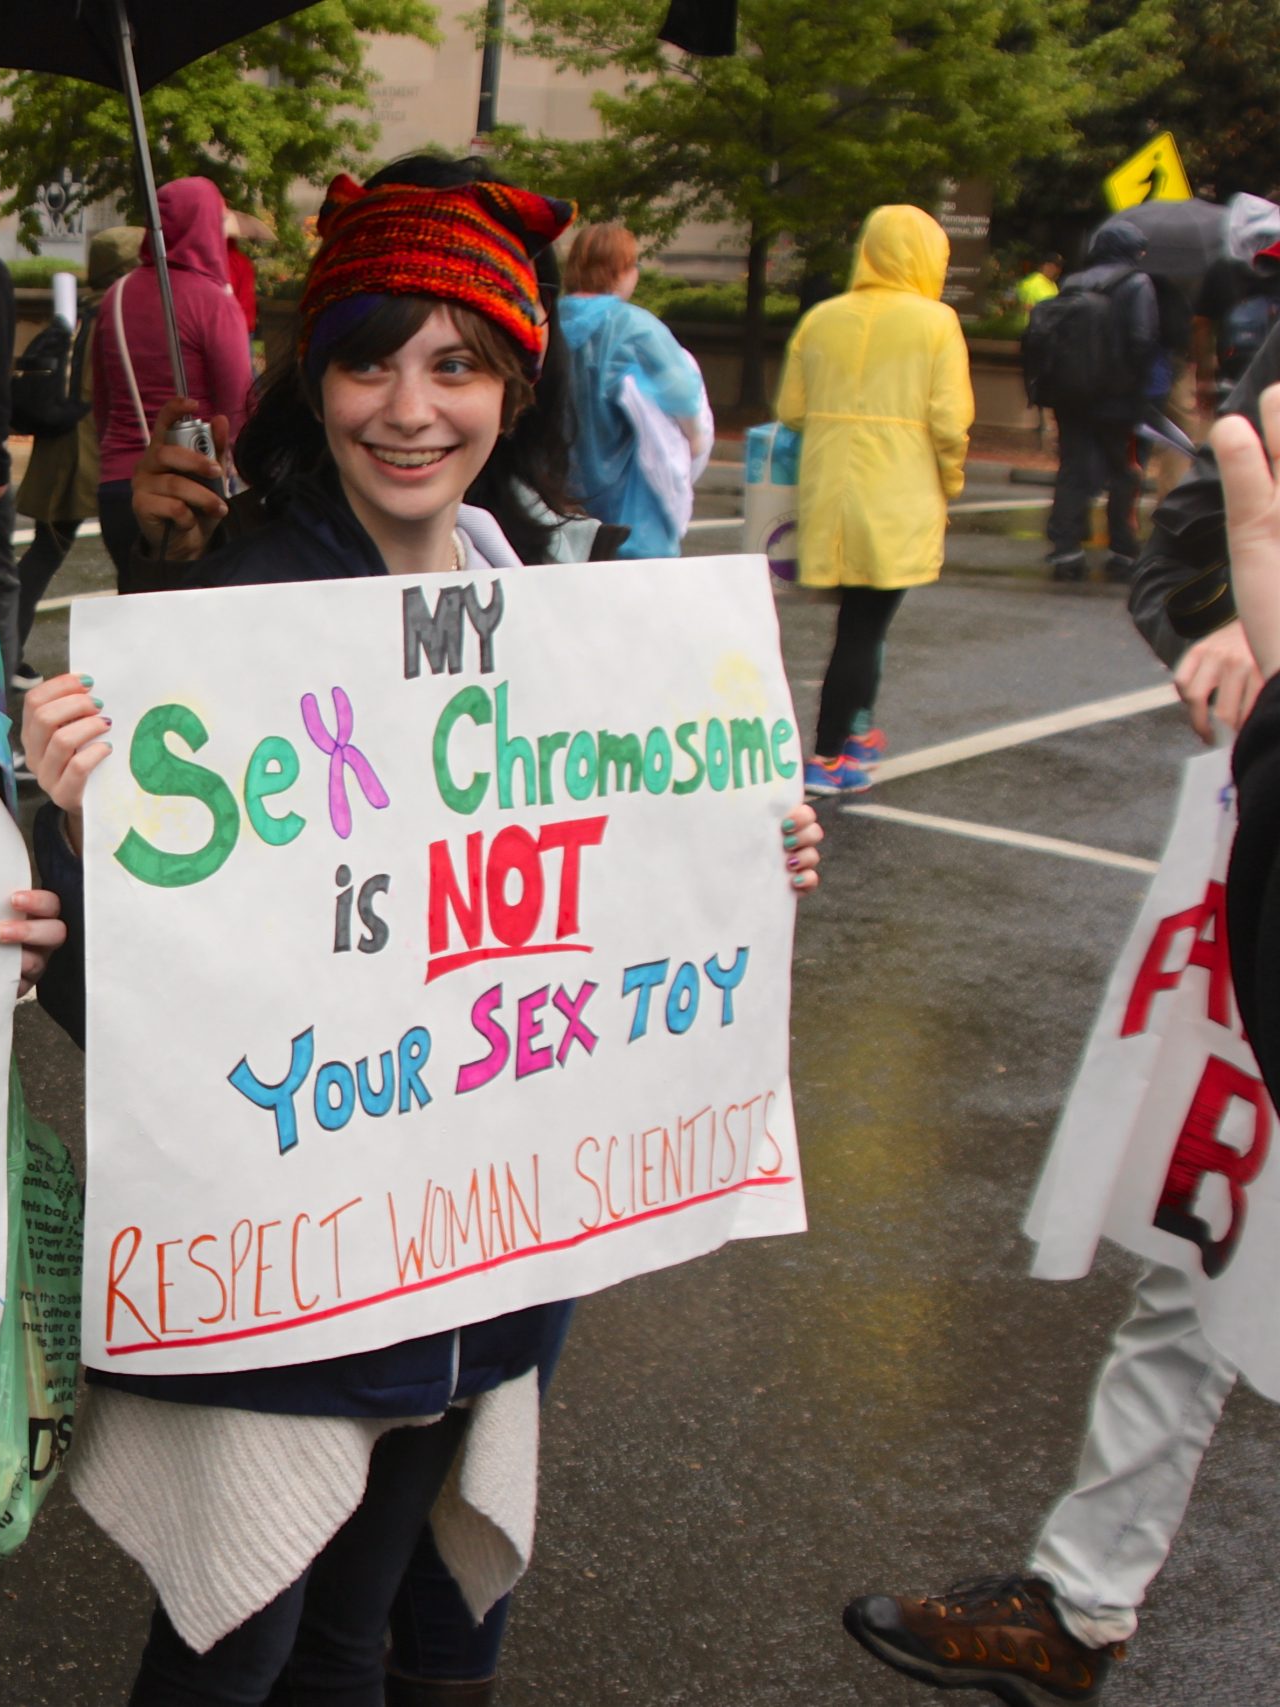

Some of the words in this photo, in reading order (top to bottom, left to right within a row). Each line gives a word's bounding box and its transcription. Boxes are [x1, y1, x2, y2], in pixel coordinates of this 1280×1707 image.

[943, 225, 971, 235] venue,
[403, 580, 503, 679] MY
[433, 681, 797, 815] Chromosome
[333, 864, 391, 954] is
[428, 816, 609, 954] NOT
[455, 981, 599, 1094] SEX
[622, 947, 750, 1044] TOY
[43, 1203, 70, 1222] bag
[106, 1196, 363, 1343] RESPECT
[387, 1153, 542, 1287] WOMAN
[574, 1091, 786, 1233] SCIENTISTS
